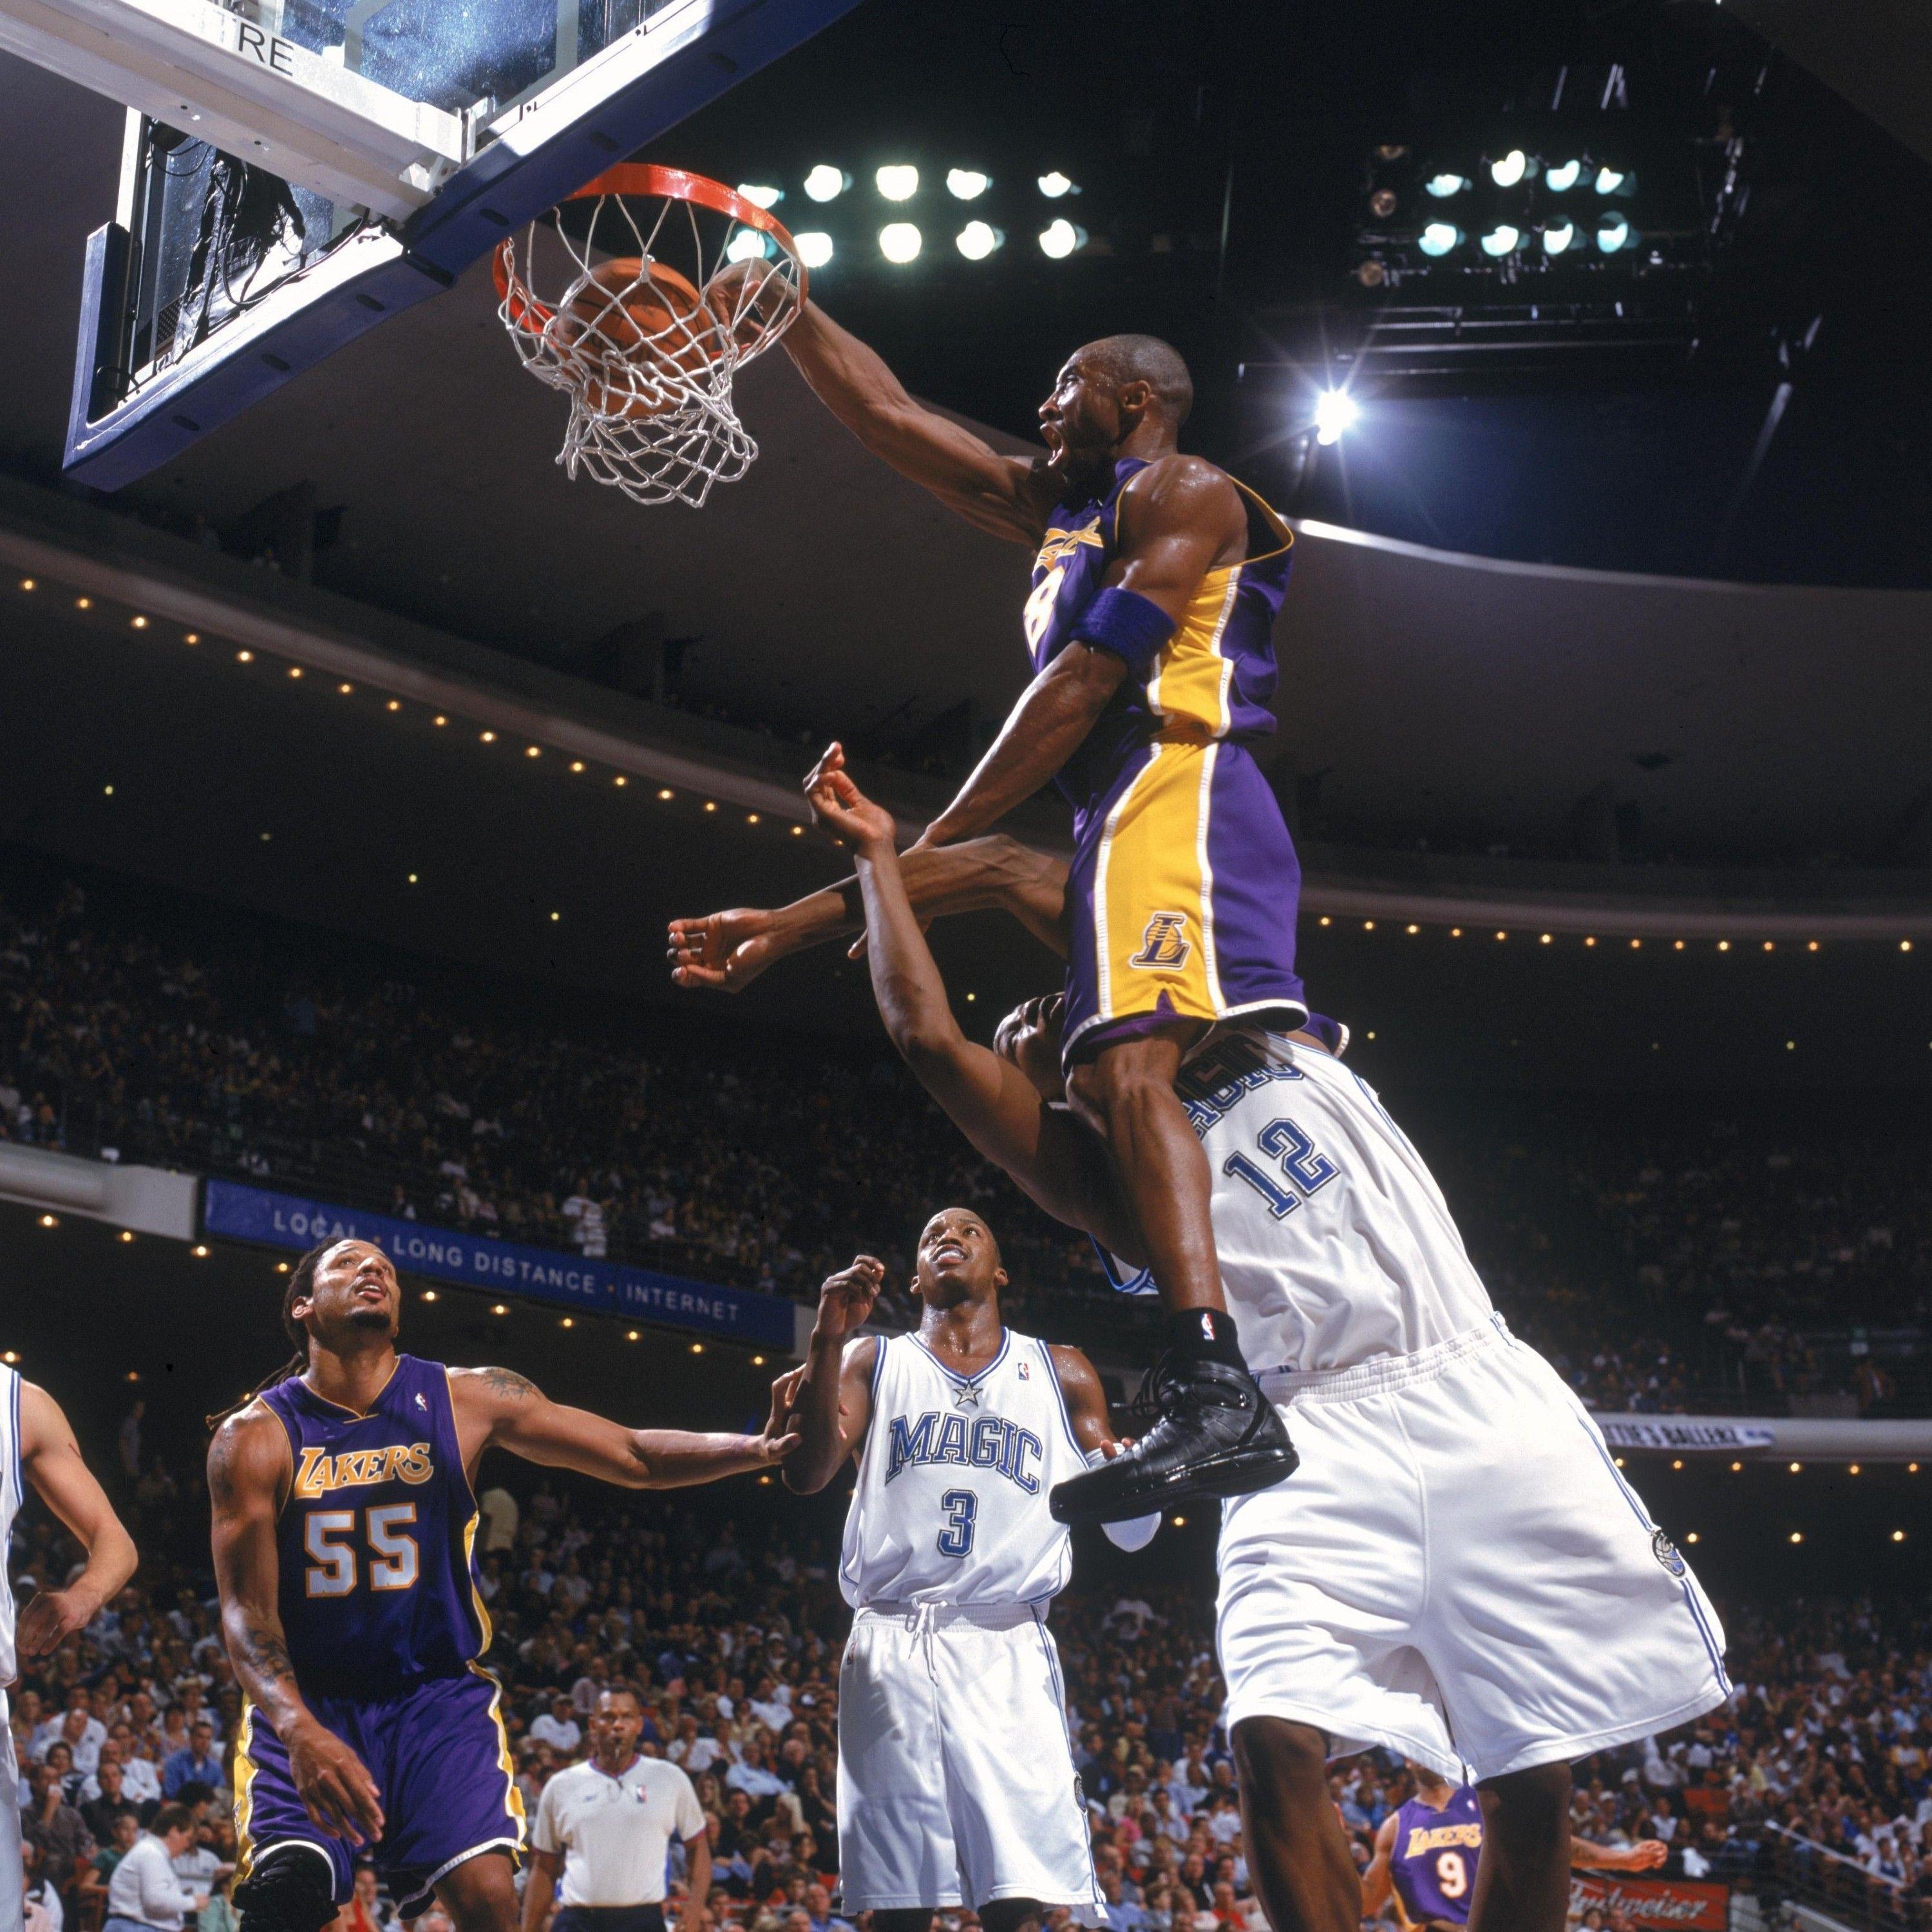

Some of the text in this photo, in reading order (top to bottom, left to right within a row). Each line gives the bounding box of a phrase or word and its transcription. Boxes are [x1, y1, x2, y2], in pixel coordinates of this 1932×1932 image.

[1024, 565, 1065, 658] 8
[1223, 1117, 1341, 1221] 12
[393, 1234, 464, 1268] LONG
[474, 1251, 596, 1294] DISTANCE
[625, 1283, 739, 1321] INTERNET
[294, 1443, 434, 1500] LAKERS
[885, 1411, 1043, 1495] MAGIC
[305, 1502, 420, 1598] 55
[937, 1488, 978, 1558] 3
[1404, 1823, 1482, 1859] LAKERS
[1436, 1851, 1468, 1899] 9
